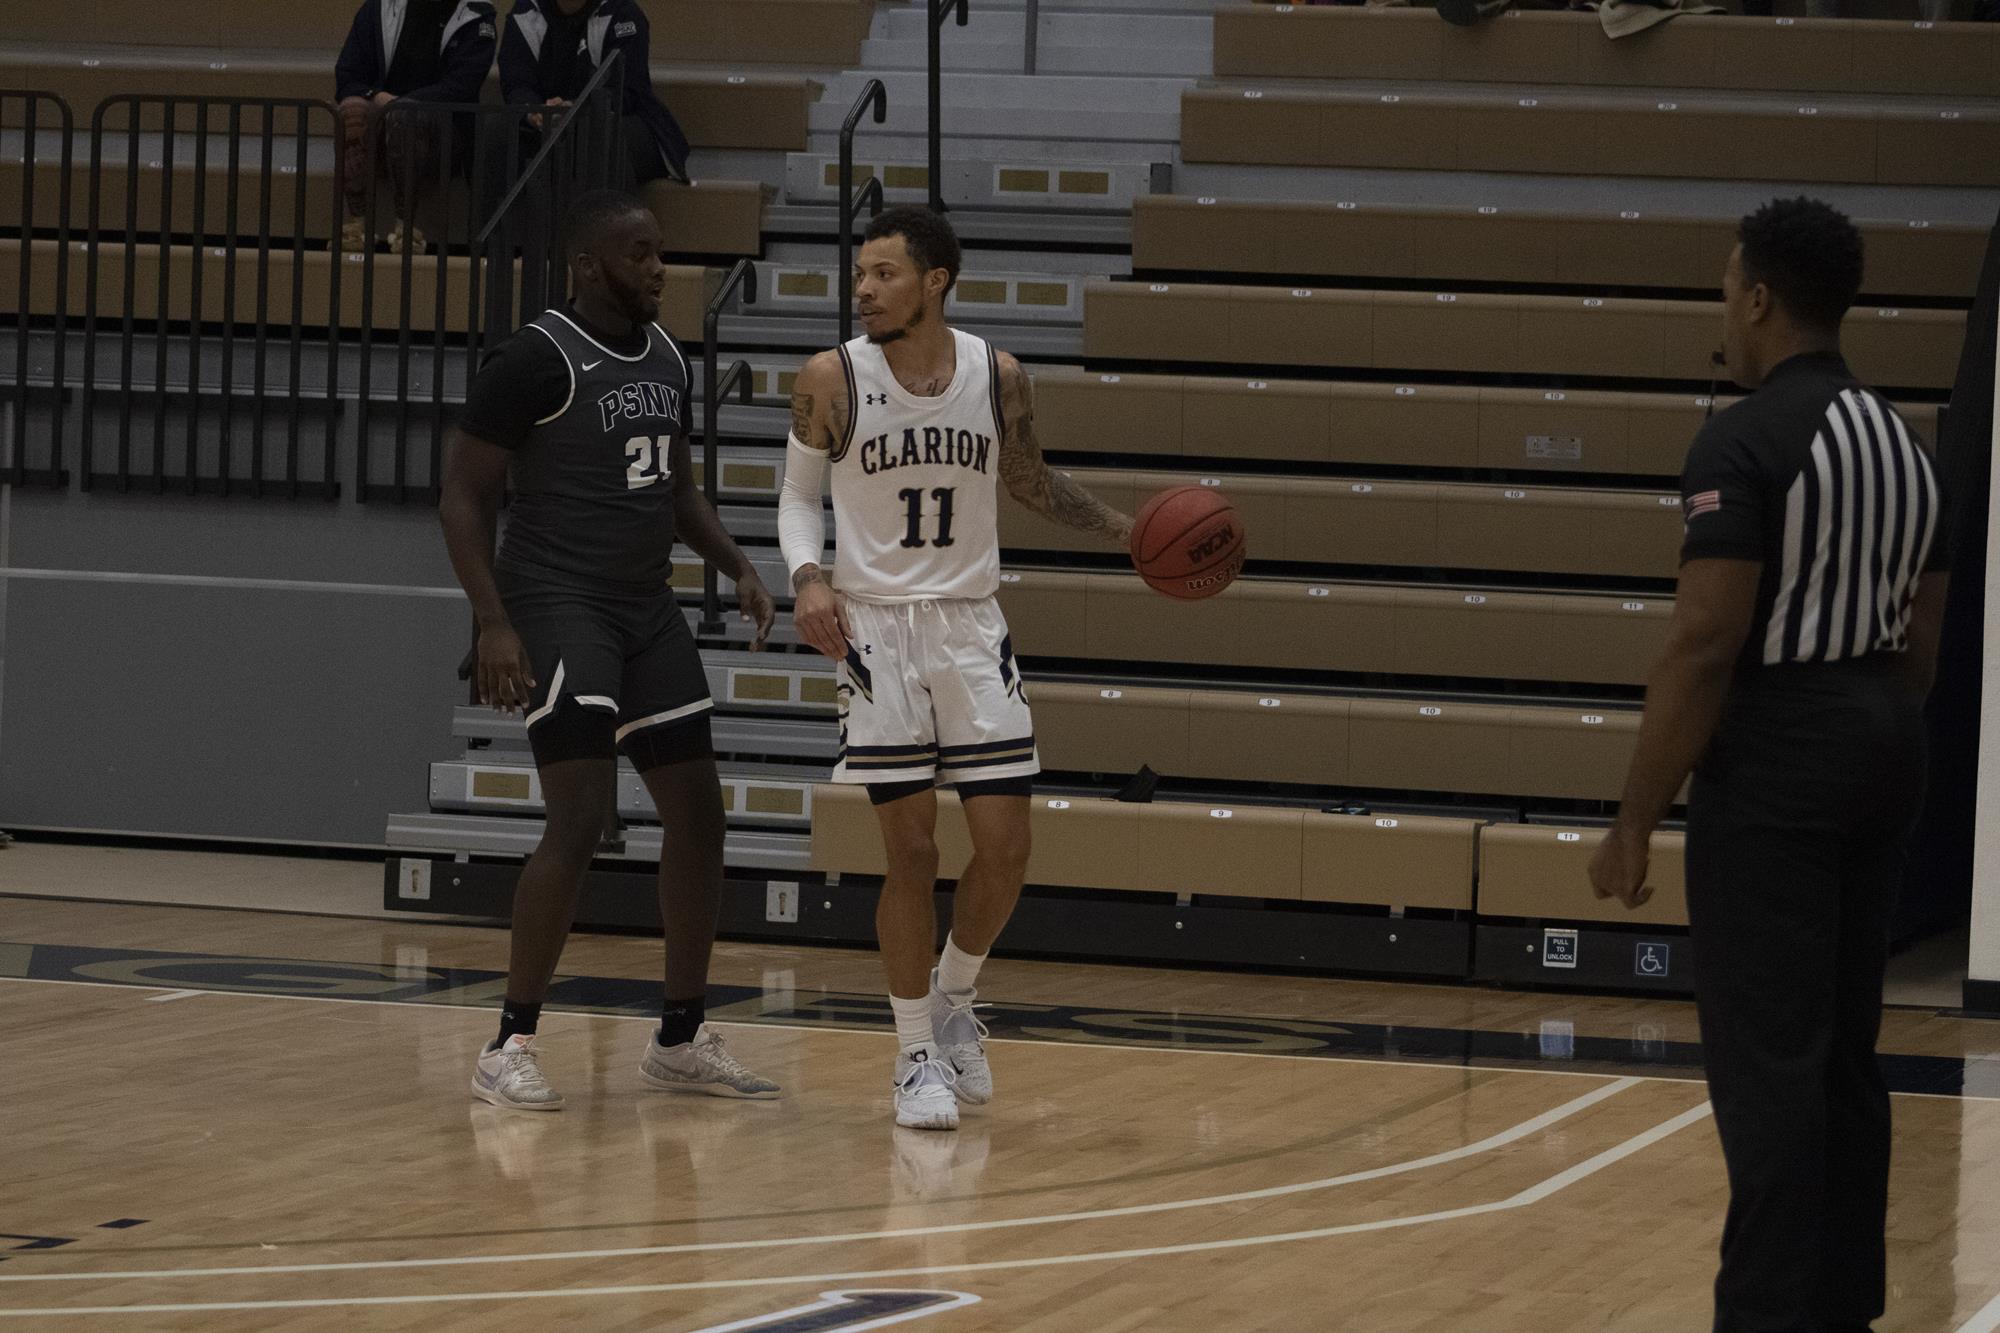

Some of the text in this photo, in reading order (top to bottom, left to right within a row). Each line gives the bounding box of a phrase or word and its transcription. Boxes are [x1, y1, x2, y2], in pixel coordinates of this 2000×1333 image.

[624, 434, 672, 490] 21
[860, 426, 991, 475] CLARION
[898, 486, 958, 548] 11
[1552, 938, 1569, 946] PULL
[1556, 945, 1565, 953] TO
[1547, 953, 1573, 961] UNLOCK
